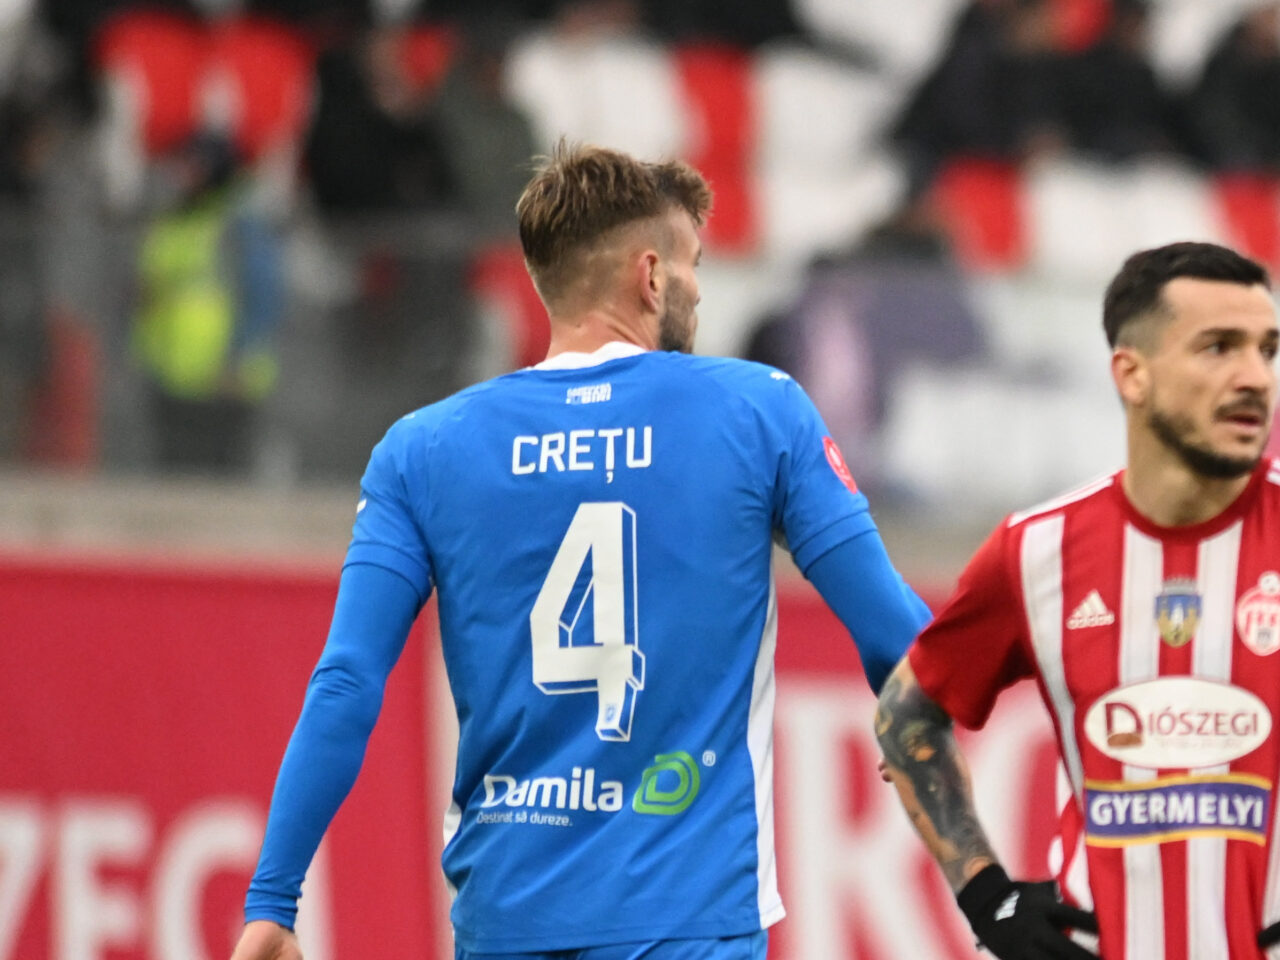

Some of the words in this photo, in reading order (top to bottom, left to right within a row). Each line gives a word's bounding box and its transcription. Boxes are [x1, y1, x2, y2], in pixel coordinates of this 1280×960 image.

[512, 426, 652, 484] CREȚU
[530, 502, 645, 742] 4
[1105, 702, 1259, 747] DIÓSZEGI
[481, 766, 623, 812] Damila
[1090, 792, 1264, 828] GYERMELYI
